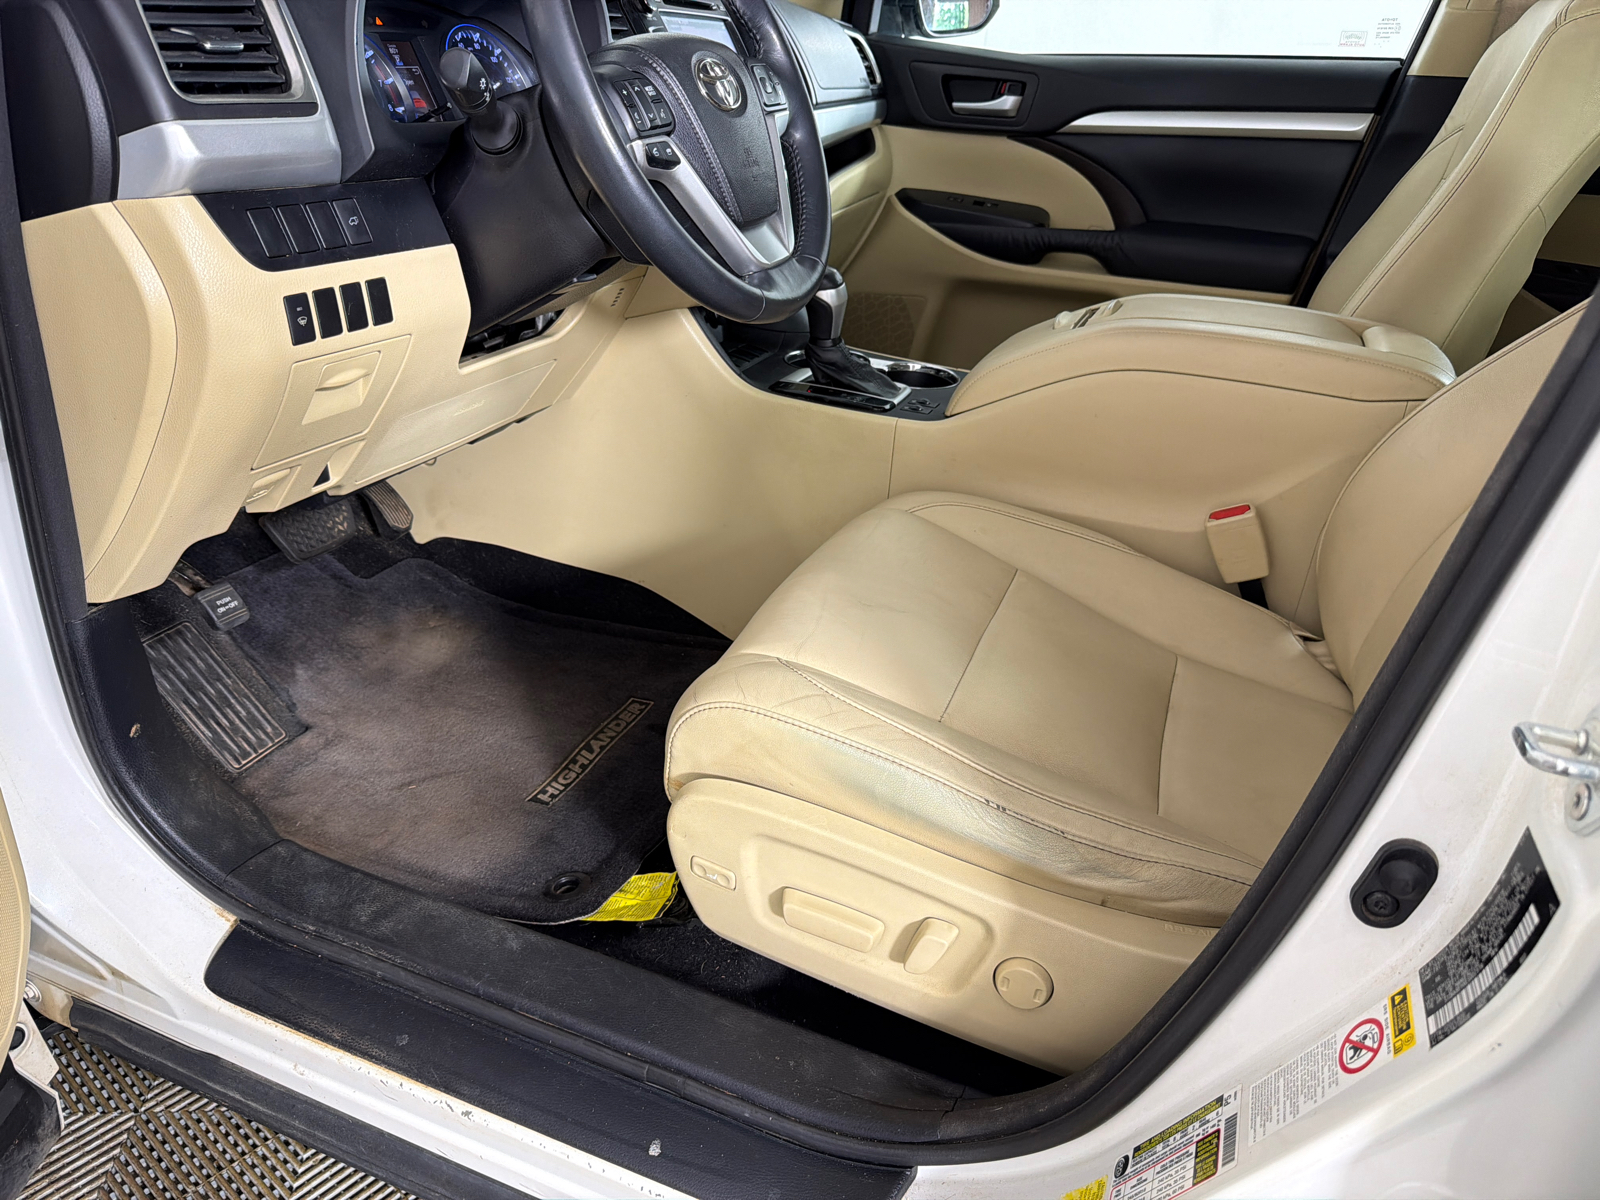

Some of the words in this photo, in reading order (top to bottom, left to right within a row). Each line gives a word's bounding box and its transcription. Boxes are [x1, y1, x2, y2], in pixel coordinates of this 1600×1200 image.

[216, 596, 232, 606] PUSH
[537, 702, 646, 803] HIGHLANDER
[1161, 1120, 1182, 1136] LOADING
[1183, 1100, 1216, 1123] INFORMATION
